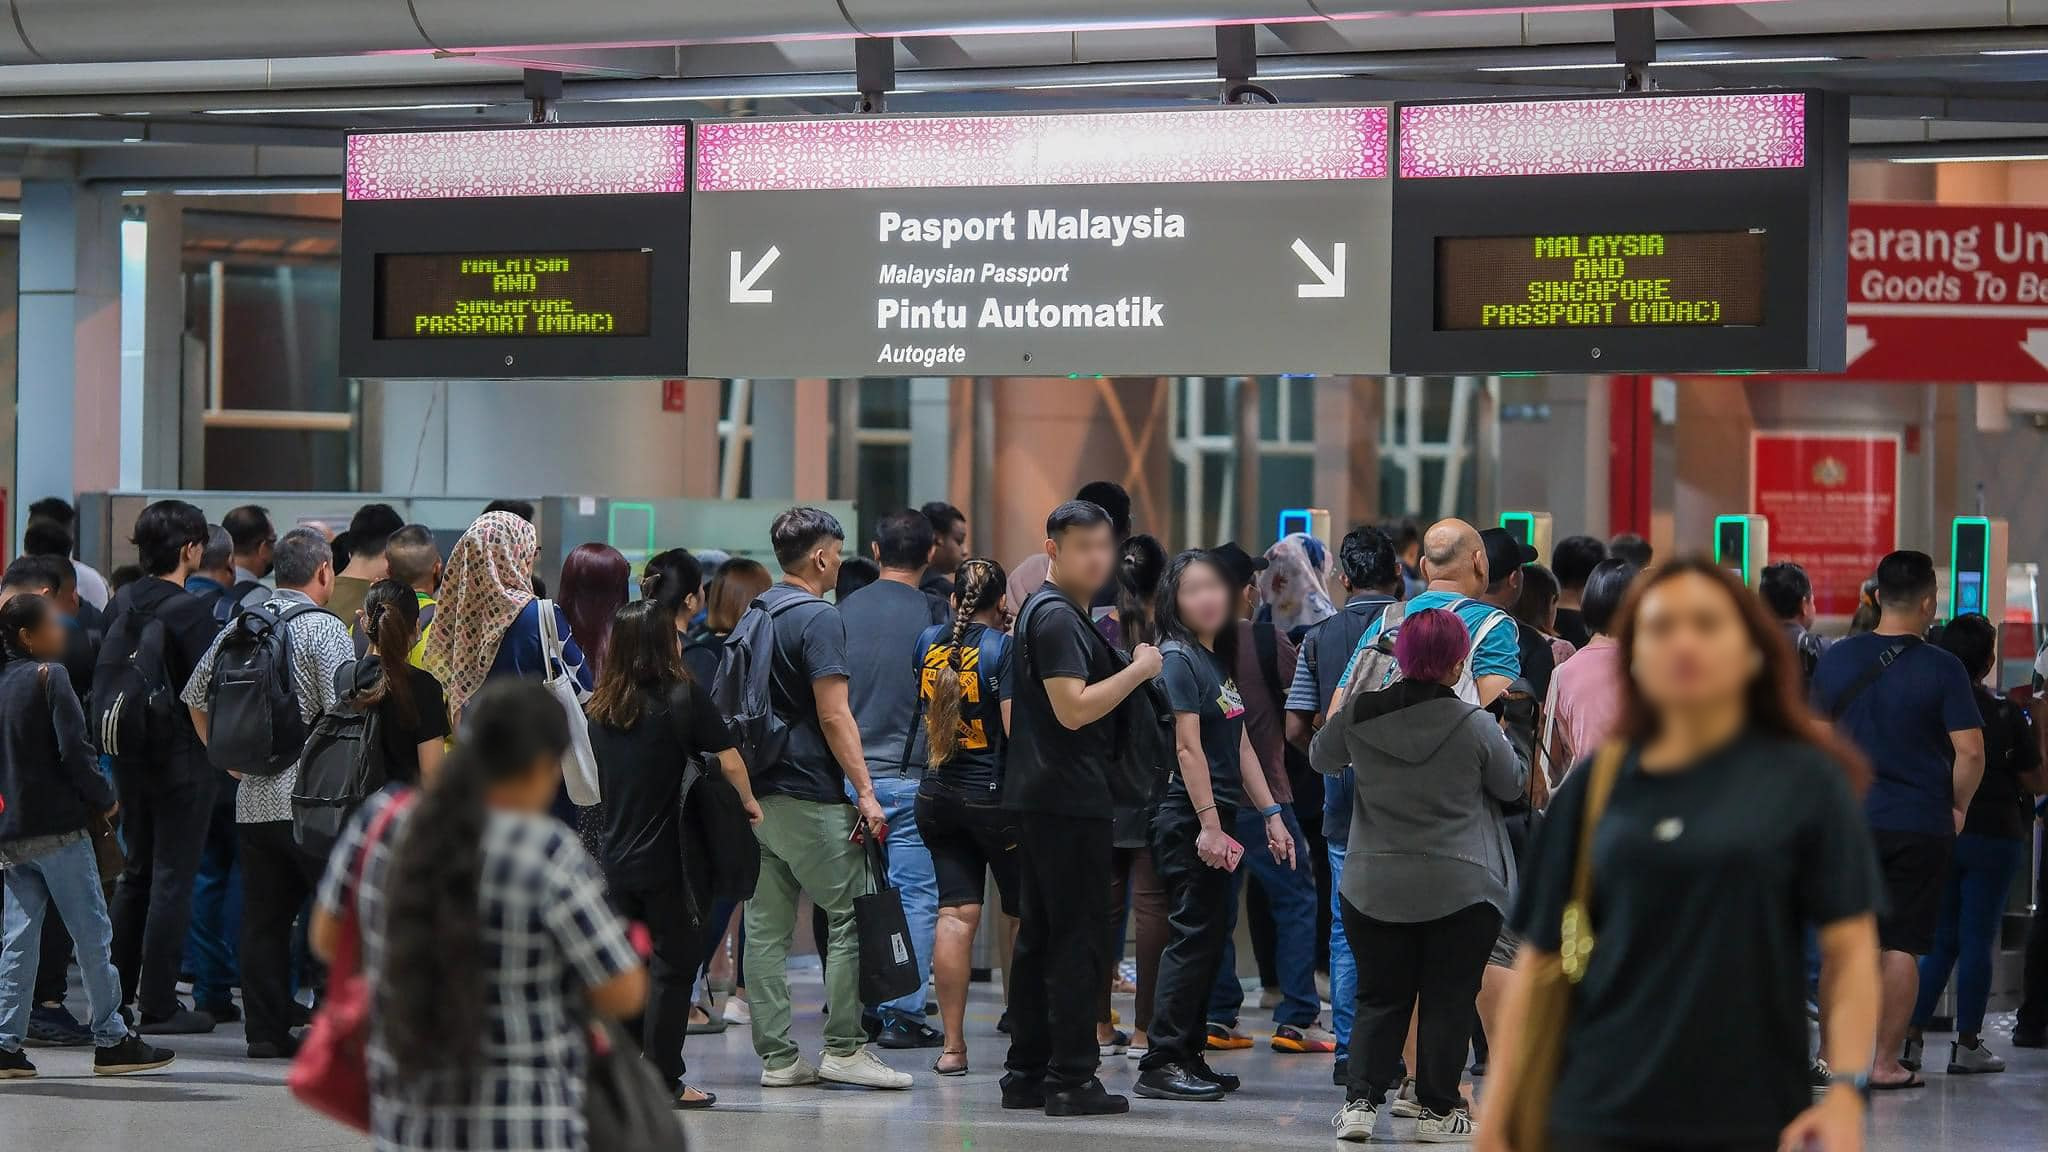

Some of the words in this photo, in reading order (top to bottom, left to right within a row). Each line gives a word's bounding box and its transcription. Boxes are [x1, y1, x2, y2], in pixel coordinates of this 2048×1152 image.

[879, 210, 1016, 249] Pasport
[1027, 207, 1185, 247] Malaysia
[1534, 234, 1665, 258] MALAYSIA
[878, 262, 976, 289] Malaysian
[980, 262, 1070, 287] Passport
[1573, 257, 1625, 280] AND
[493, 273, 537, 293] AND
[1527, 279, 1671, 303] SINGAPORE
[1860, 268, 1961, 301] Goods
[1973, 270, 2008, 301] To
[415, 314, 527, 334] PASSPORT
[537, 313, 613, 333] (MDAC)
[877, 297, 968, 329] Pintu
[977, 296, 1165, 328] Automatik
[1482, 302, 1617, 326] PASSPORT
[1629, 300, 1721, 323] (MDAC)
[877, 343, 967, 368] Autogate
